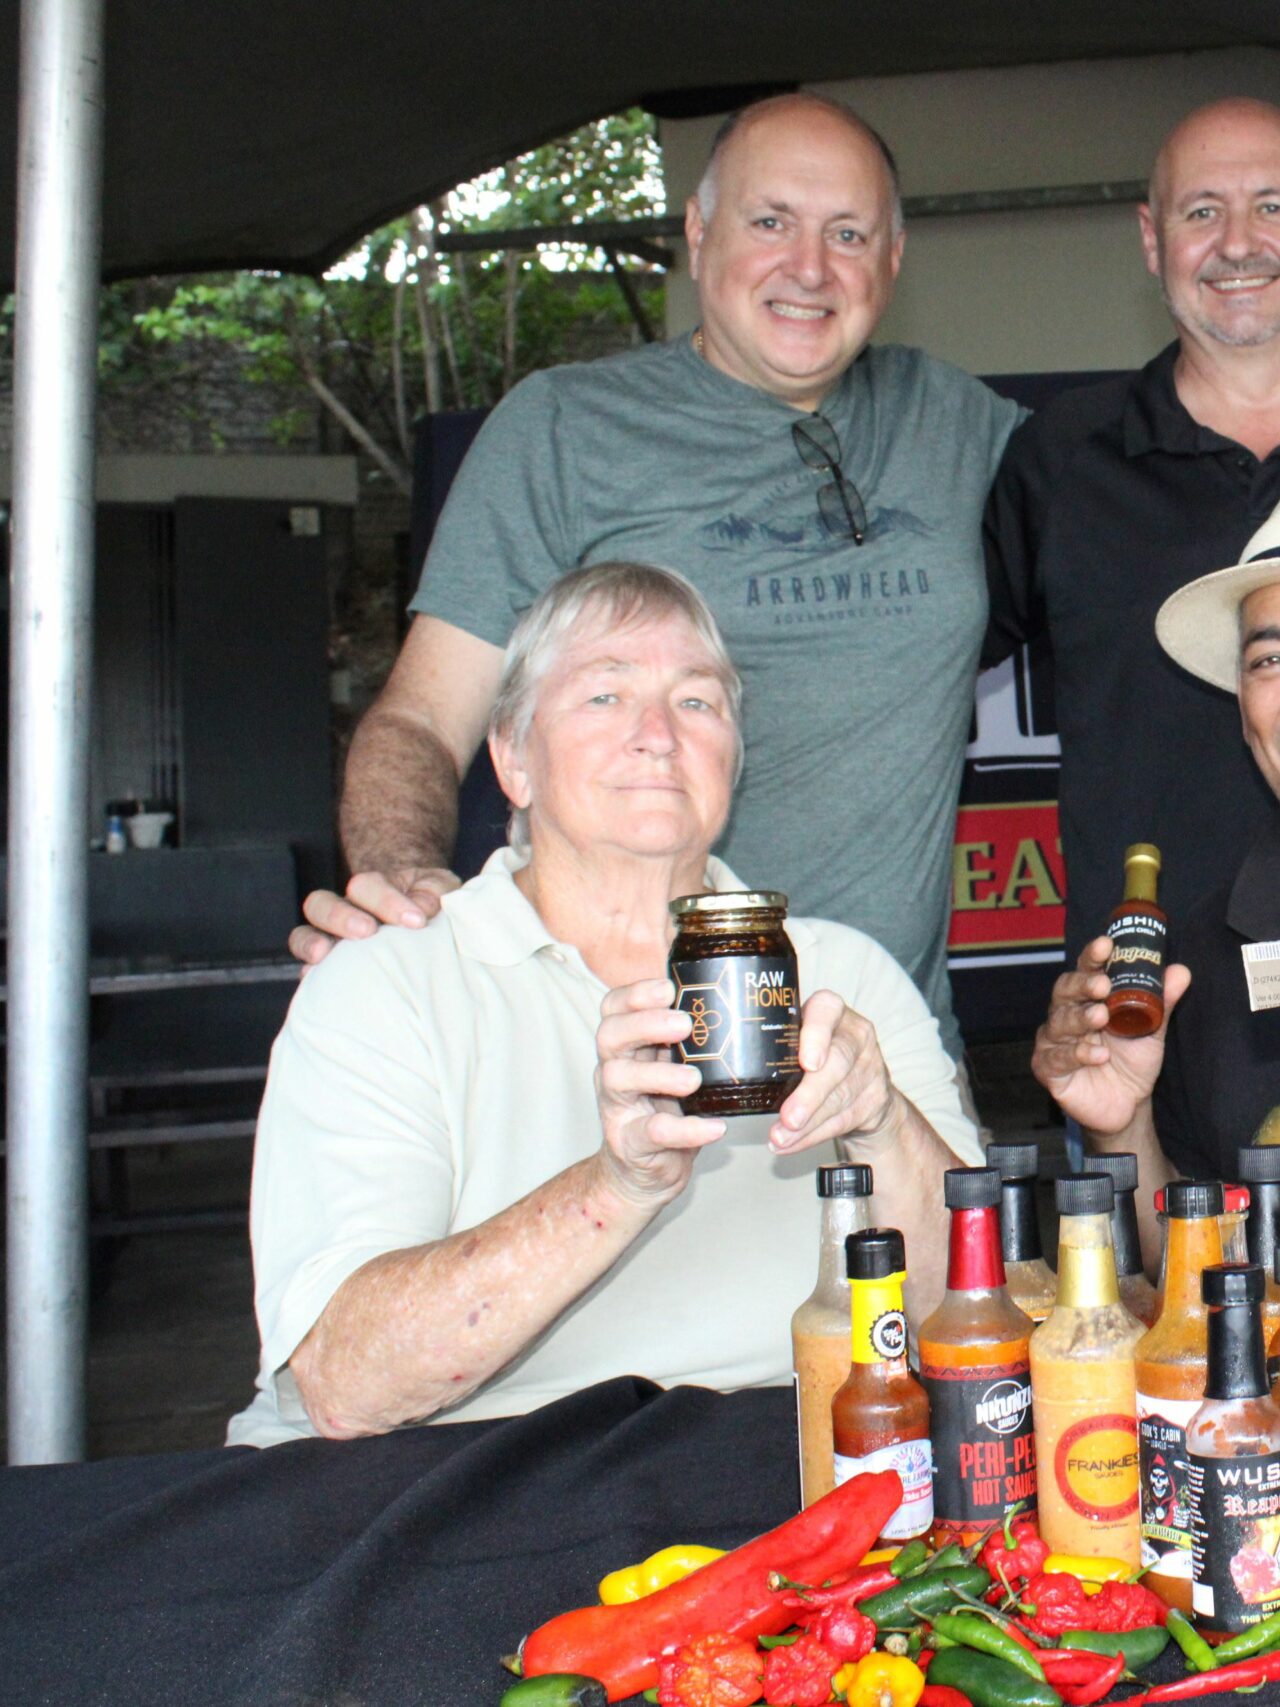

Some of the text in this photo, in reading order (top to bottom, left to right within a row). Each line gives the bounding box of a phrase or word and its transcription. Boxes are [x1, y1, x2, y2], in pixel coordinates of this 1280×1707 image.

[746, 568, 930, 607] ARROWHEAD
[952, 838, 1064, 911] EA
[744, 970, 785, 989] RAW
[745, 987, 797, 1008] HONEY
[976, 1385, 1032, 1425] NKUNZI
[1160, 1427, 1181, 1443] CABIN
[972, 1478, 1001, 1507] HOT
